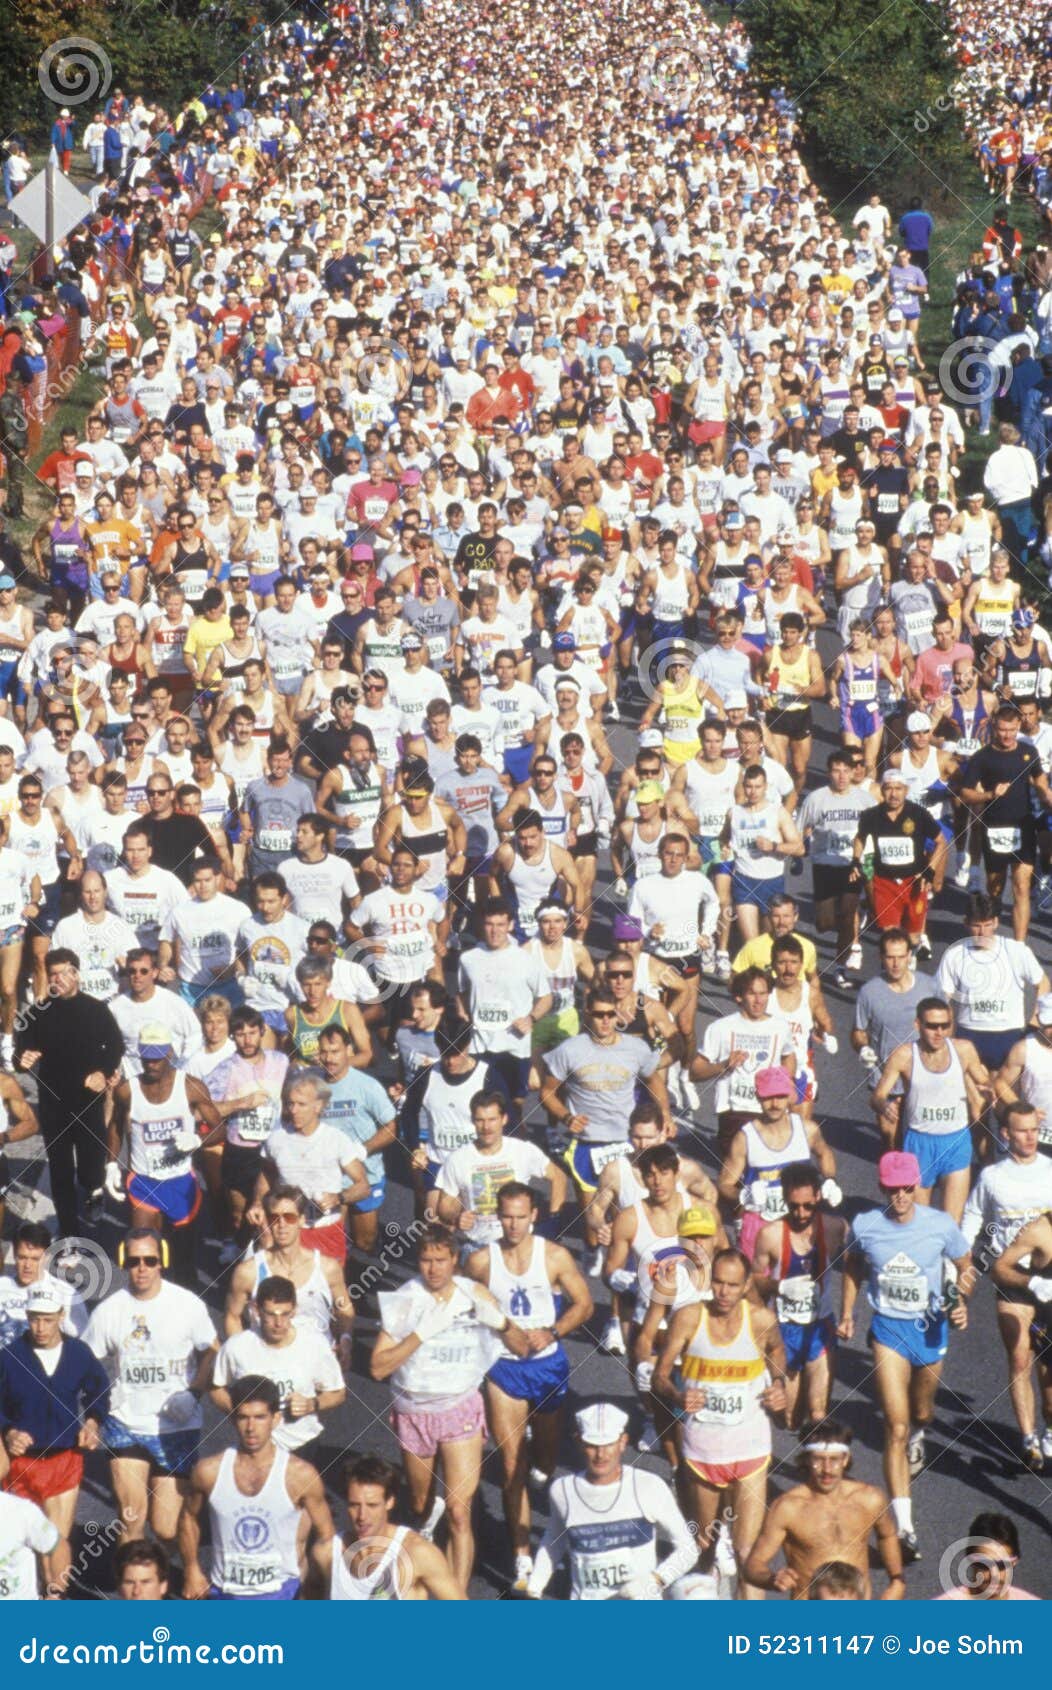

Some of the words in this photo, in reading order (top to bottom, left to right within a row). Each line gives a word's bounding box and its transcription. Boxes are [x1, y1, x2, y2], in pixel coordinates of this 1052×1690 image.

[465, 543, 486, 555] GO
[882, 844, 910, 857] A9361
[389, 904, 425, 918] HO
[923, 1107, 957, 1121] A1697
[148, 1120, 178, 1133] BUD
[888, 1287, 920, 1302] A426
[126, 1366, 166, 1384] A9075
[230, 1566, 274, 1586] A1205
